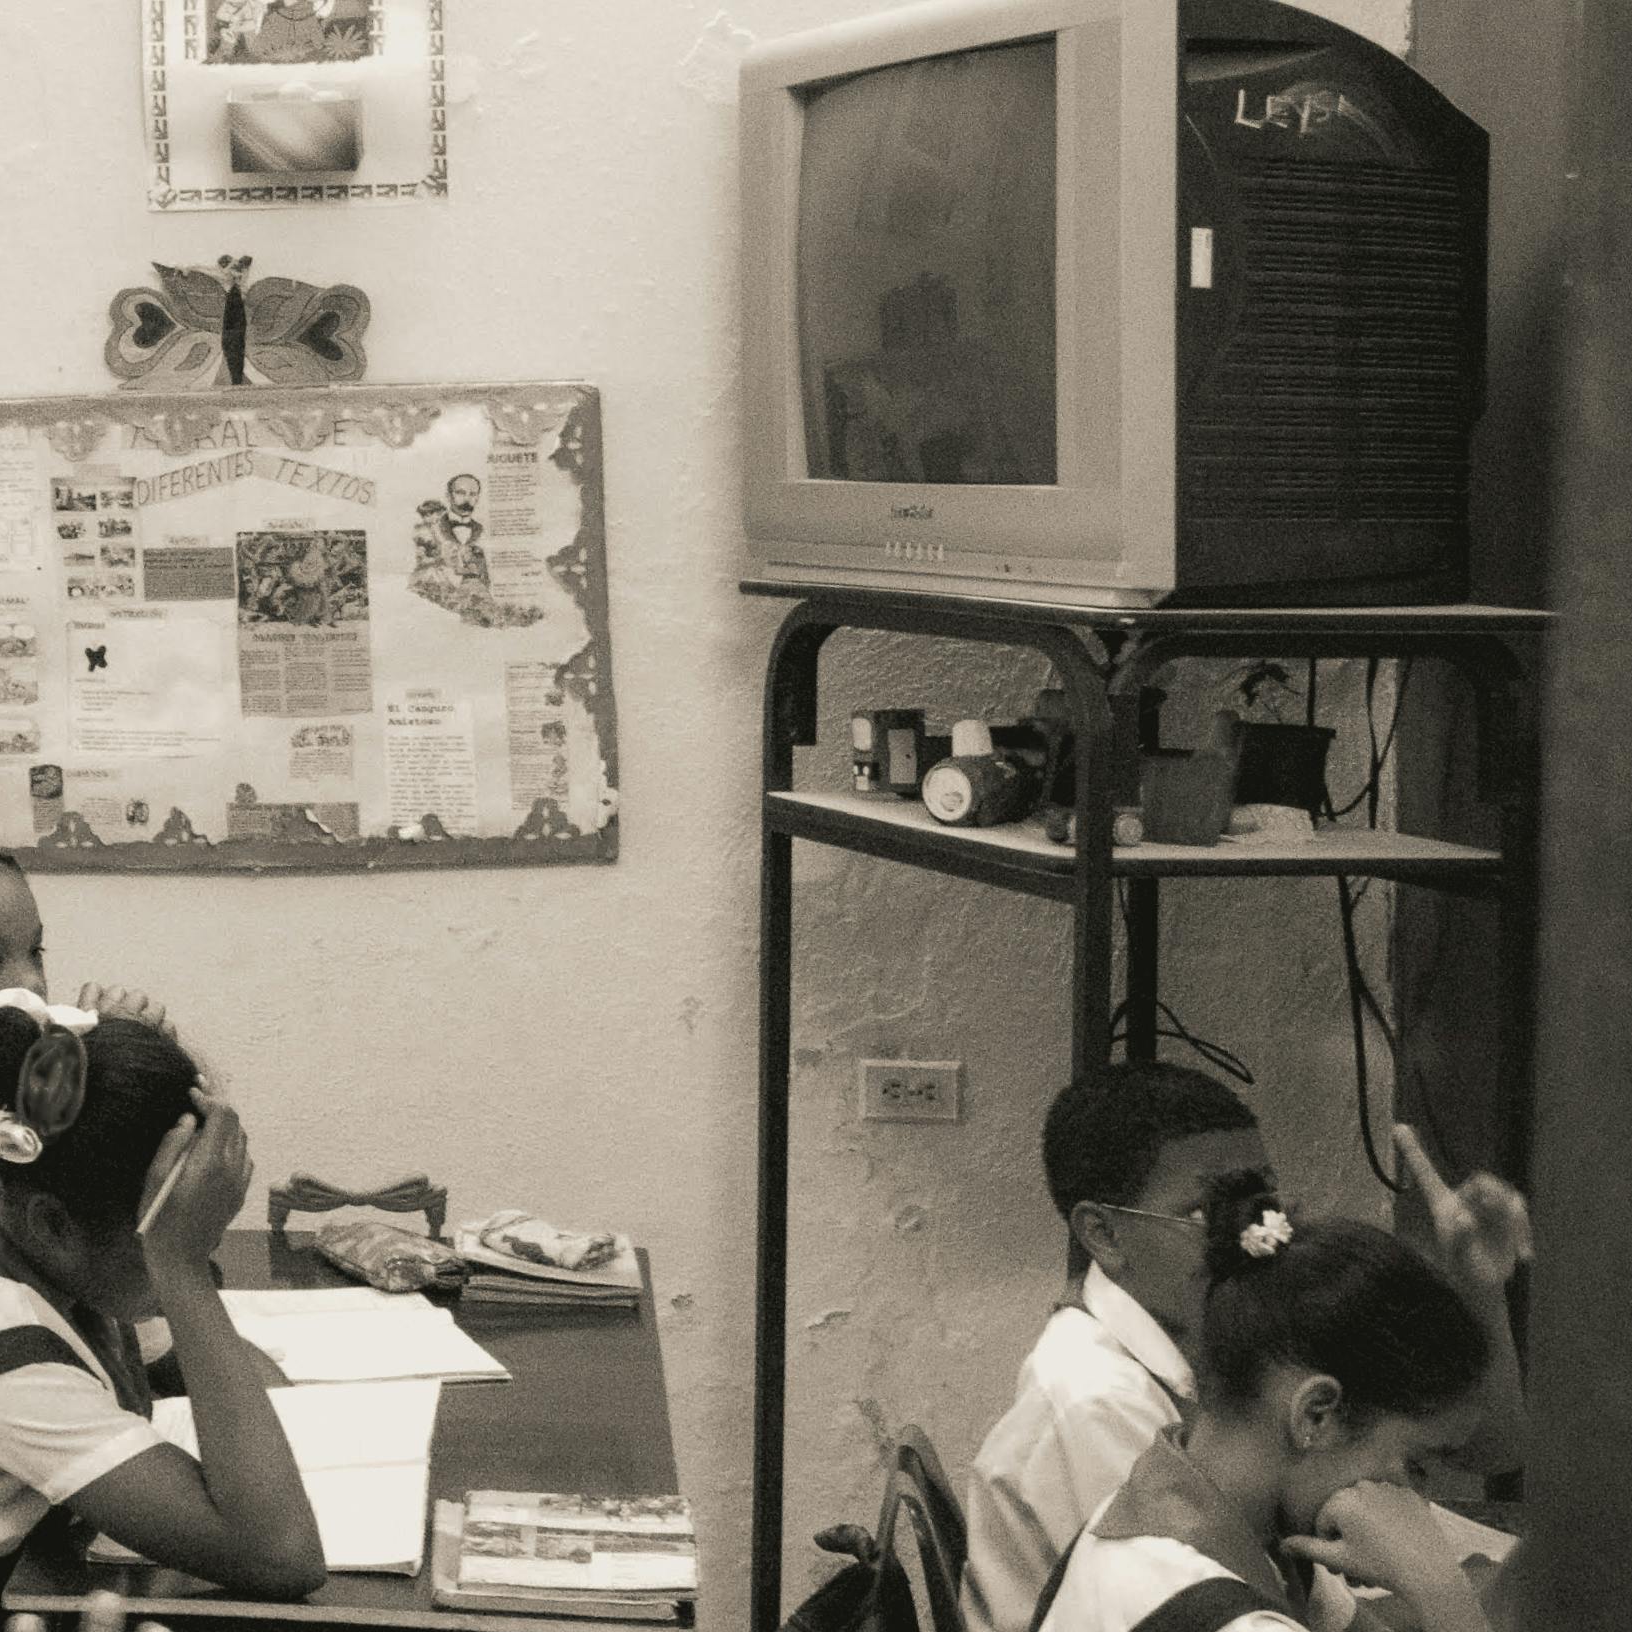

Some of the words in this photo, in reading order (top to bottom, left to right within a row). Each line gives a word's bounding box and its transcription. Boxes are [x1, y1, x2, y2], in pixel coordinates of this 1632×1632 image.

[137, 449, 255, 506] DIFERENTES
[275, 457, 376, 505] TEXTOS
[407, 704, 455, 714] Canguro
[387, 718, 442, 726] Amistoso
